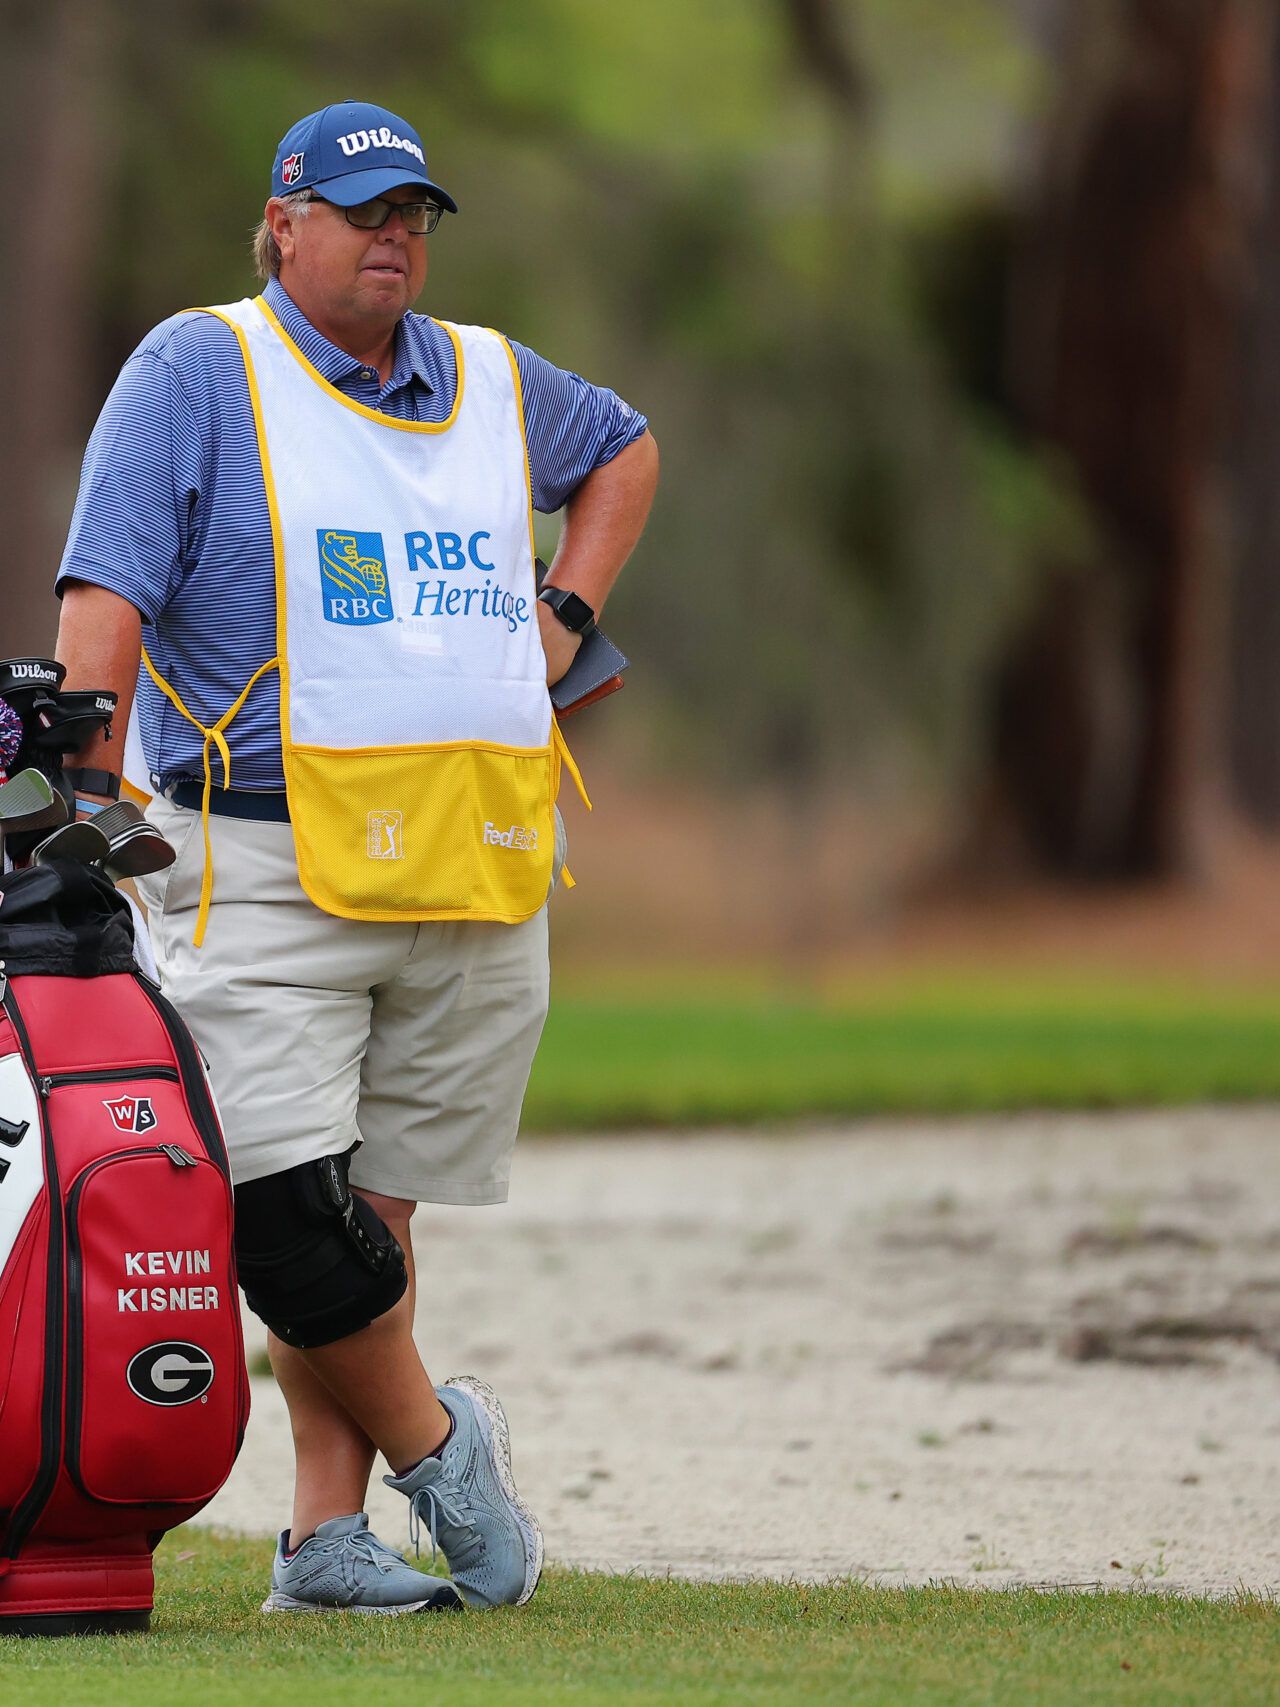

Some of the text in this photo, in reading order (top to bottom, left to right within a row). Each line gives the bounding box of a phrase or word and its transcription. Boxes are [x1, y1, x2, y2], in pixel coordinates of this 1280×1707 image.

[336, 127, 426, 165] Wilson
[404, 530, 496, 572] RBC
[330, 598, 389, 619] RBC
[9, 663, 58, 682] Wilson
[124, 1249, 211, 1276] KEVIN
[117, 1286, 219, 1313] KISNER
[126, 1341, 215, 1406] G
